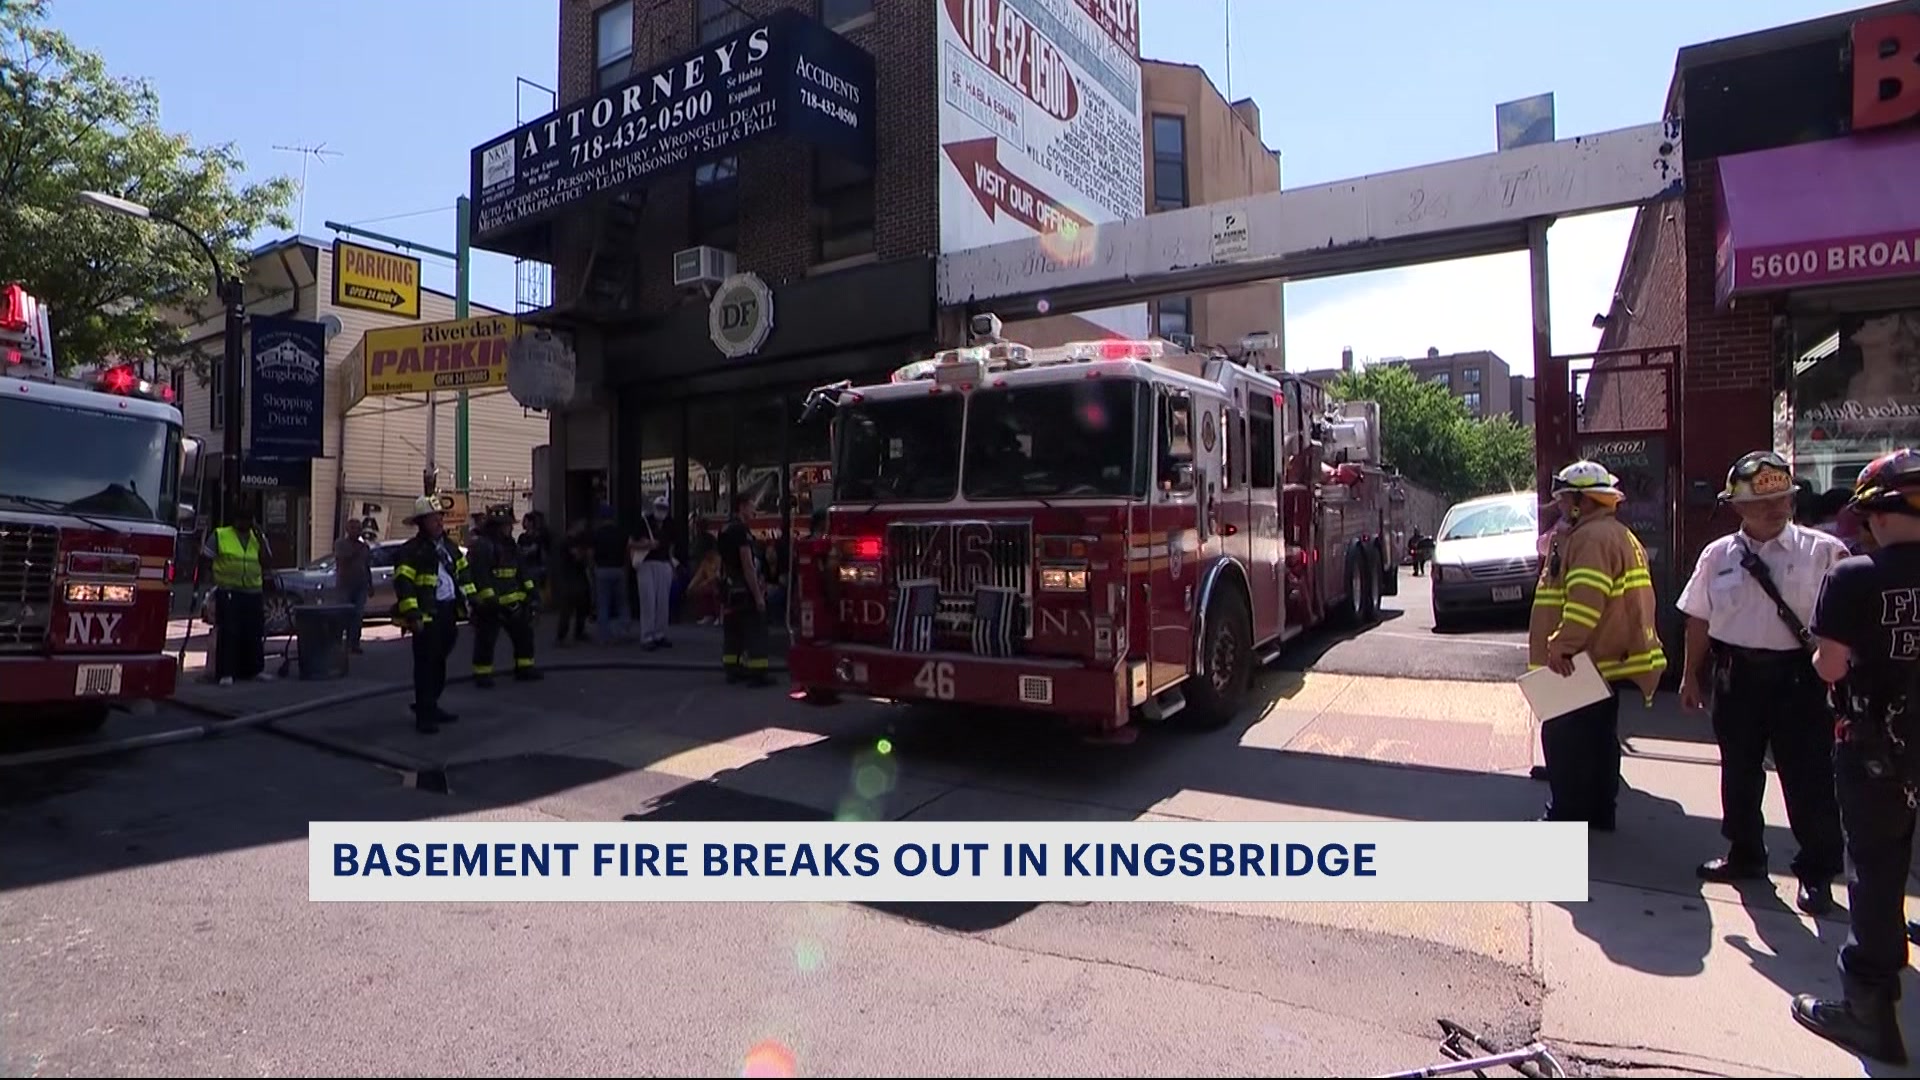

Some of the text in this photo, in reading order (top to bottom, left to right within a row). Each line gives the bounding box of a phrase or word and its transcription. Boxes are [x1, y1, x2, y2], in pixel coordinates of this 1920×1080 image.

[522, 26, 769, 159] ATTORNEYS
[738, 67, 763, 84] Habla
[796, 54, 860, 104] ACCIDENTS
[800, 88, 858, 128] 718-432-0500
[570, 89, 713, 168] 718-432-0500
[478, 212, 516, 234] MEDICAL
[518, 187, 583, 218] MALPRACTICE
[596, 169, 626, 191] LEAD
[627, 146, 688, 180] POISONING
[703, 133, 730, 152] SLIP
[731, 129, 741, 142] &
[744, 114, 777, 136] FALL
[502, 186, 550, 213] ACCIDENTS
[557, 163, 609, 192] PERSONAL
[610, 146, 650, 174] INJURY
[658, 117, 728, 152] WRONGFUL
[730, 98, 777, 127] DEATH
[974, 160, 1007, 202] VISIT
[1009, 183, 1034, 218] OUR
[345, 248, 413, 287] PARKING
[1750, 238, 1920, 279] 5600 BROA
[349, 286, 367, 298] OPEN
[367, 288, 376, 300] 24
[422, 320, 506, 343] Riverdale
[371, 337, 508, 377] PARKIN
[435, 372, 453, 386] OPEN
[263, 393, 313, 412] Shopping
[268, 411, 308, 427] District
[241, 475, 279, 486] ABOGADO
[65, 611, 122, 645] N.Y.
[914, 660, 955, 699] 46
